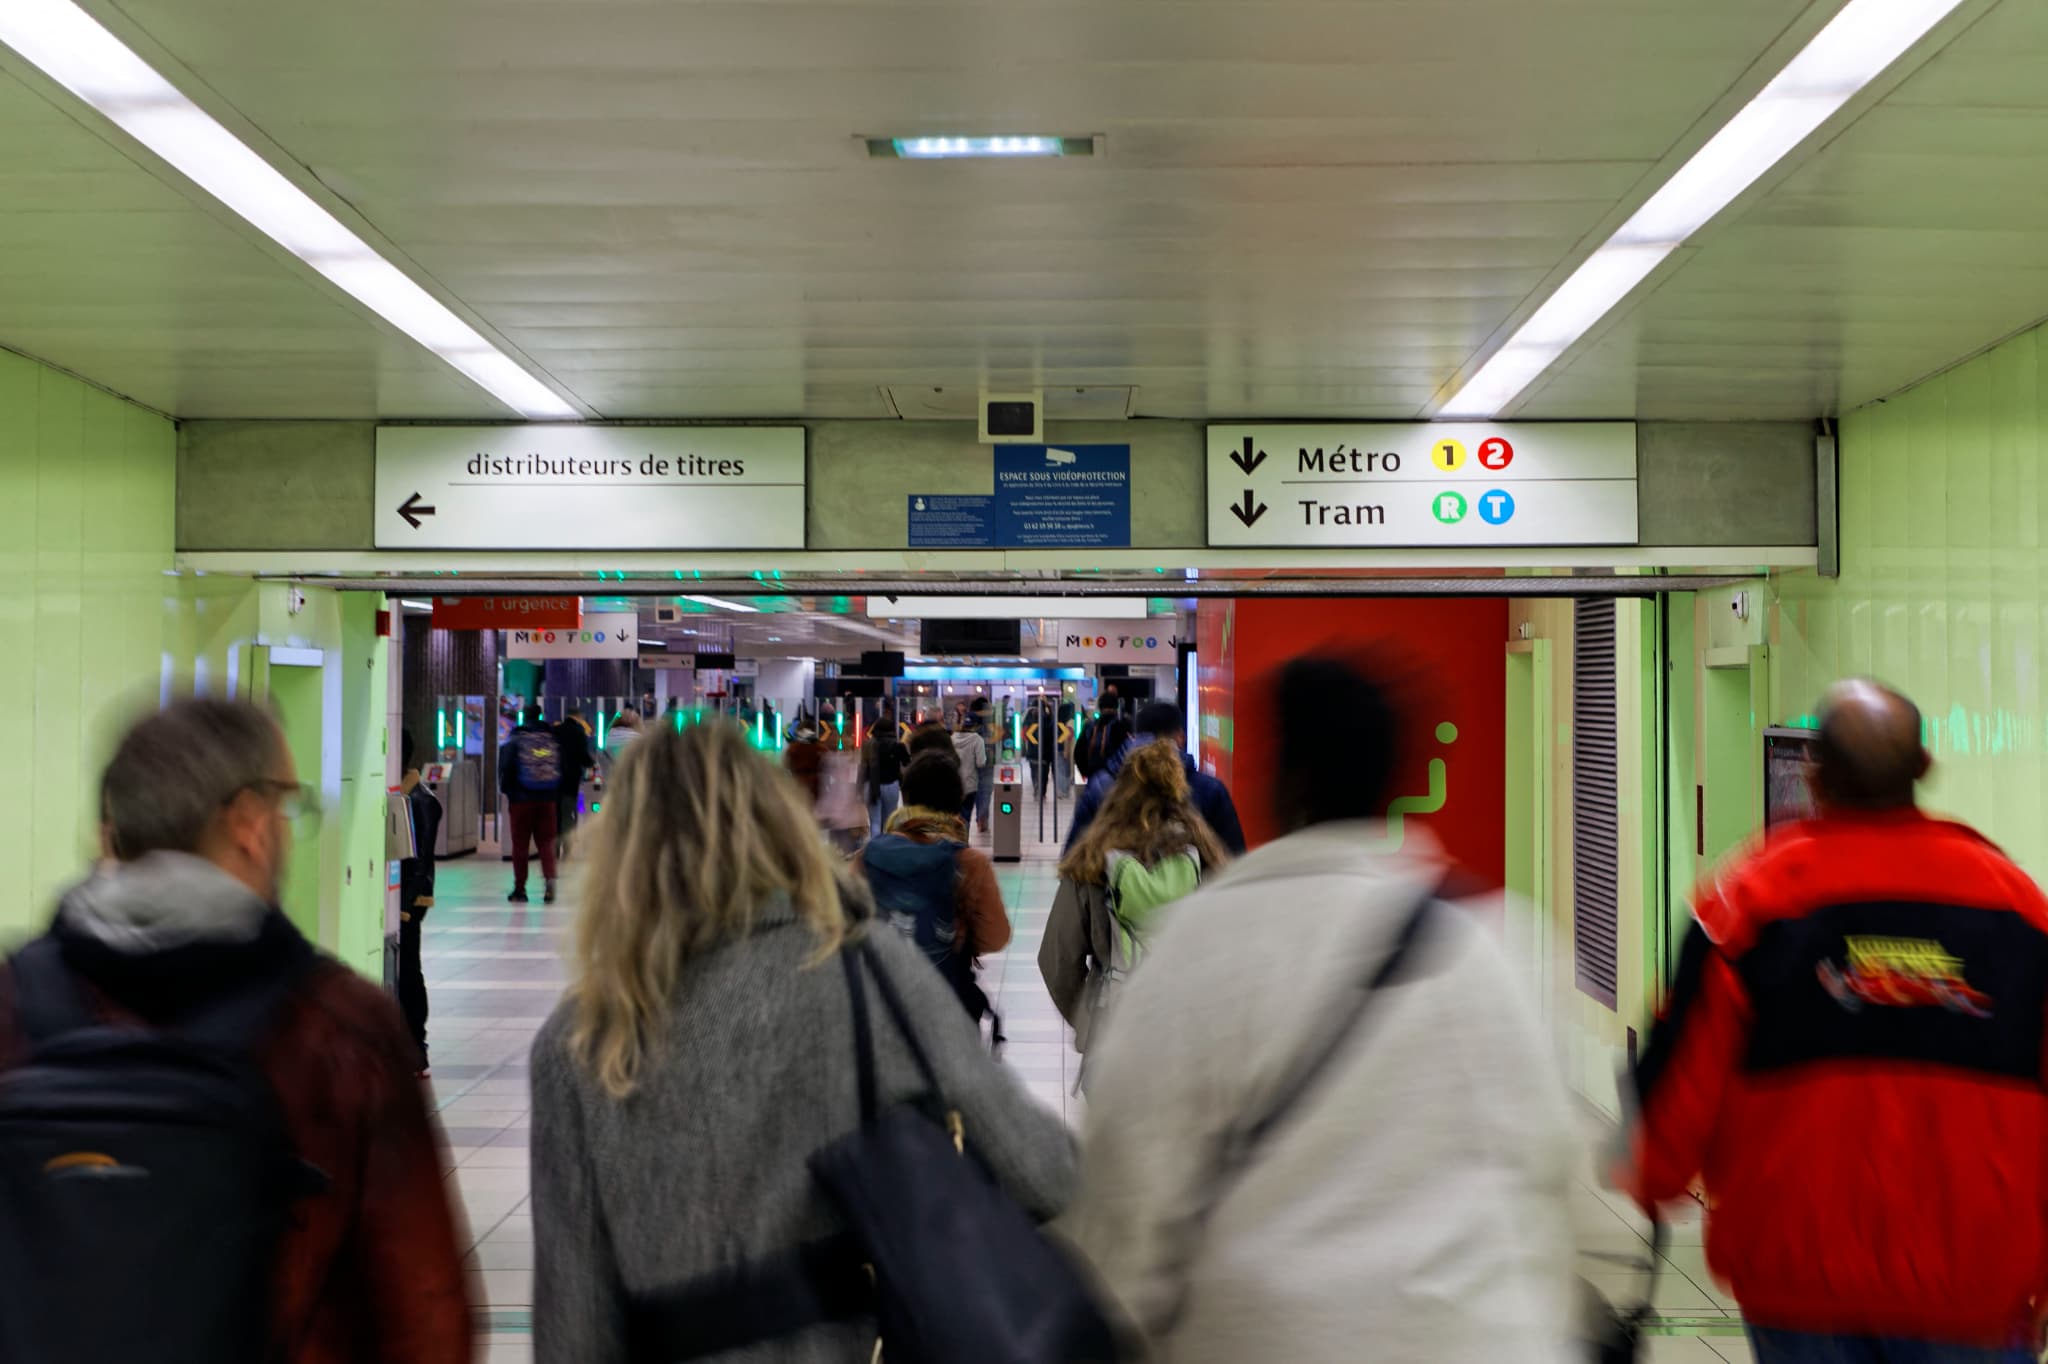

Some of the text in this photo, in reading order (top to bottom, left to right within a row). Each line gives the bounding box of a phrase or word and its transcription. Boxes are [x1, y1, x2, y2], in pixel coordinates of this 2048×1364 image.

[467, 453, 745, 476] distributeurs de titres
[1298, 444, 1401, 473] Métro
[1486, 442, 1505, 466] 2
[999, 469, 1126, 481] ESPACE SOUS VIDÉOPROTECTION
[1298, 500, 1385, 525] Tram
[1440, 496, 1461, 520] R
[483, 597, 569, 613] durgence
